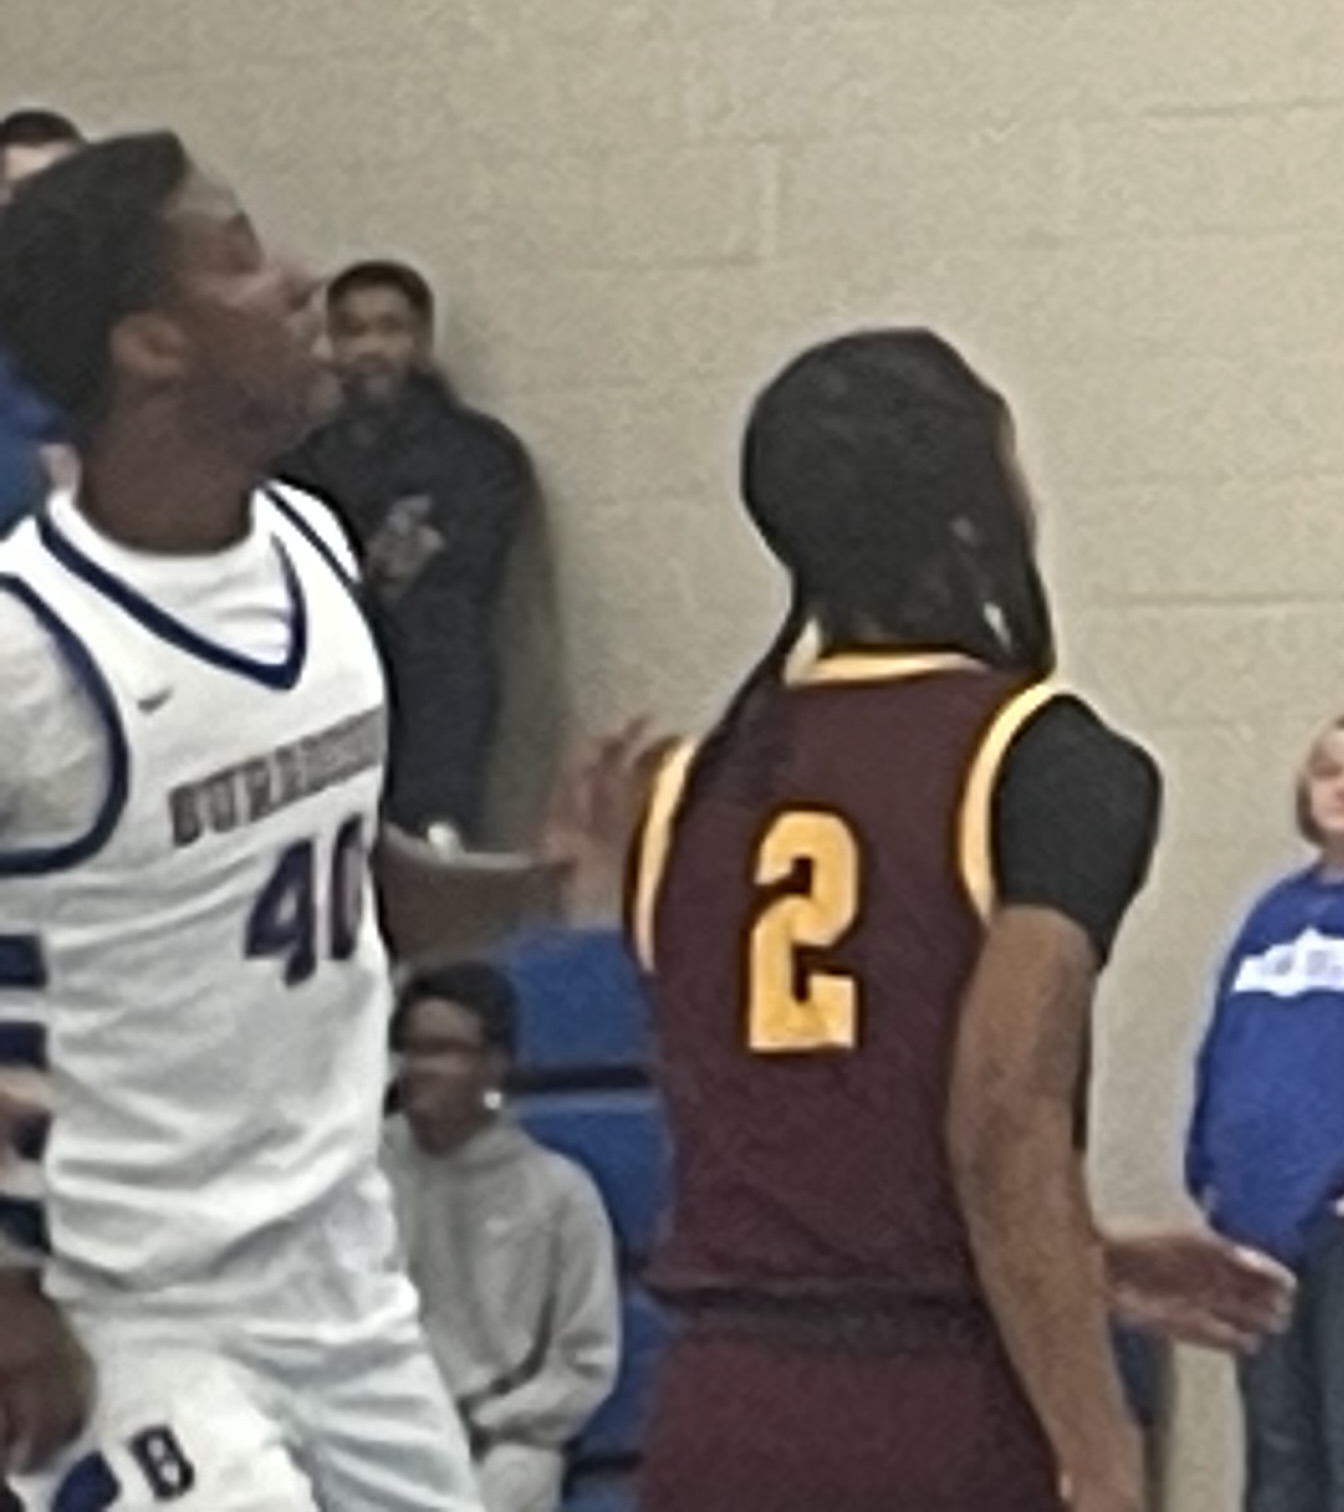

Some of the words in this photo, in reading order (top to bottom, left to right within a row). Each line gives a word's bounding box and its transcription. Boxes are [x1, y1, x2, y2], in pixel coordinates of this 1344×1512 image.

[244, 812, 363, 988] 40
[747, 811, 859, 1053] 2
[130, 1424, 195, 1501] B
